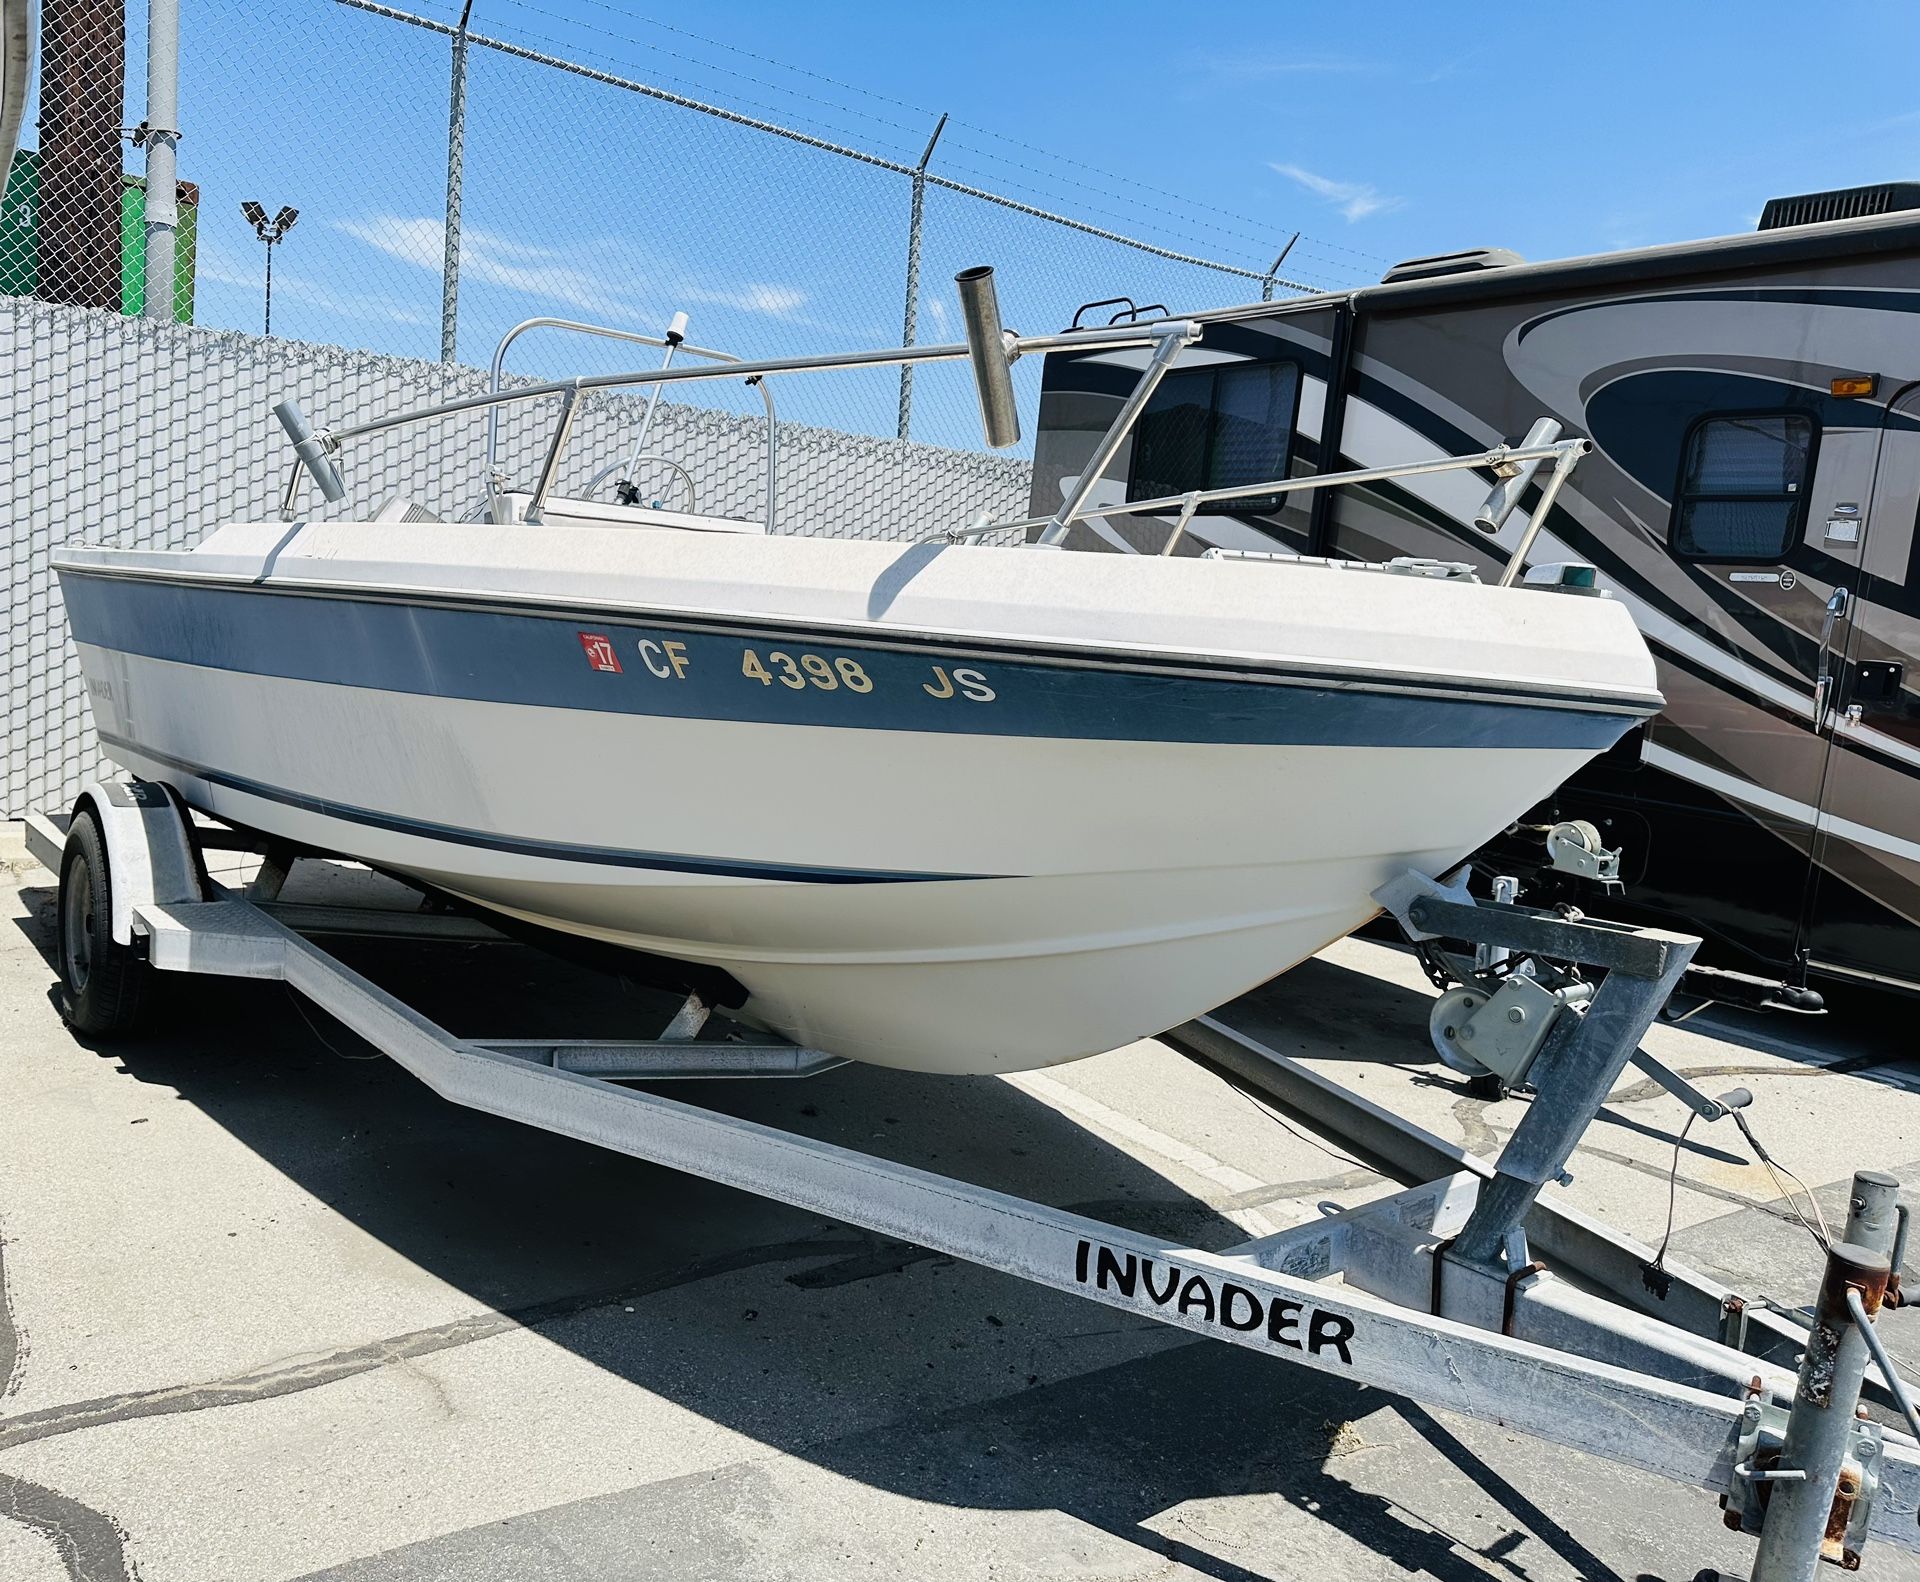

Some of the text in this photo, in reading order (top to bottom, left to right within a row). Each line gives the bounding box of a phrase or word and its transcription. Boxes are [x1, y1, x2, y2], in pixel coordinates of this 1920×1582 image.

[19, 204, 31, 227] 3
[593, 641, 614, 665] 17
[638, 639, 997, 702] CF 4398 JS
[1075, 1239, 1355, 1366] INVADER
